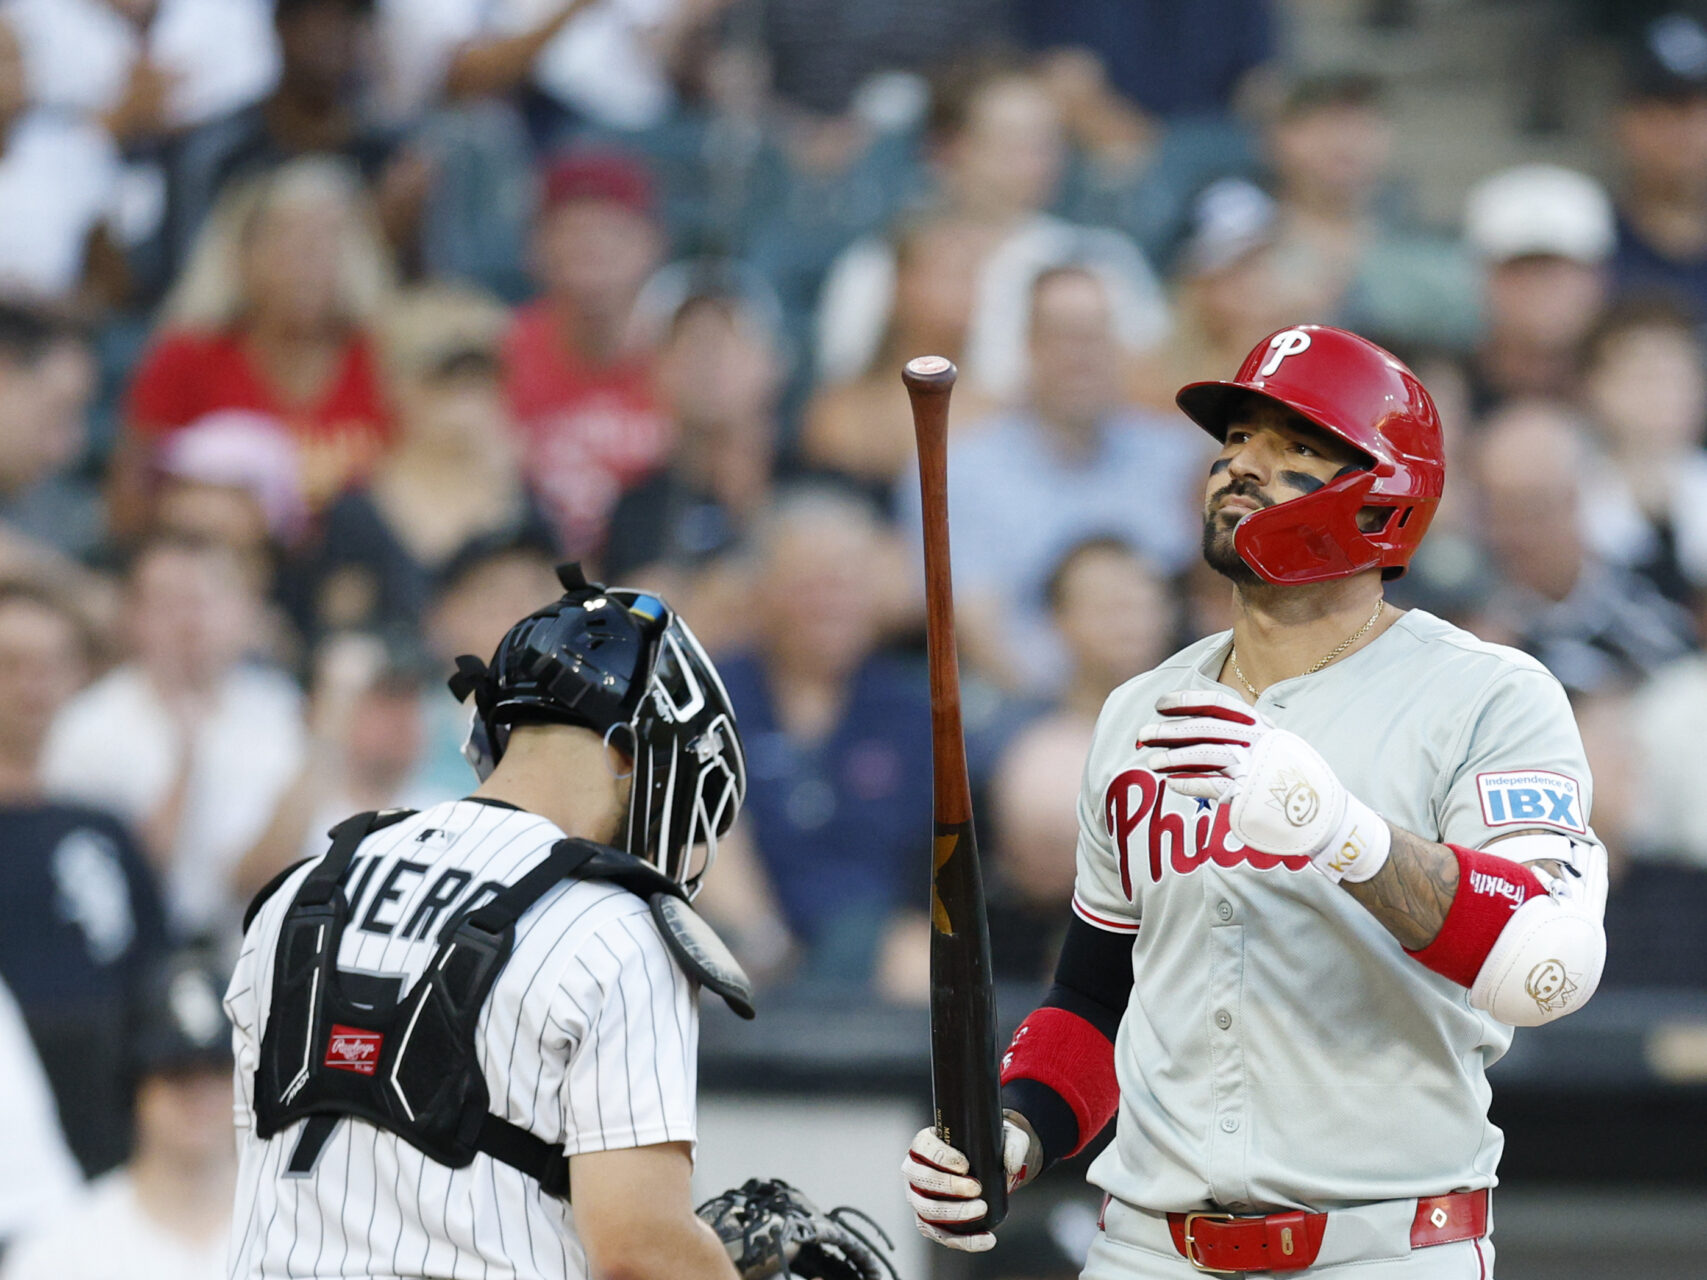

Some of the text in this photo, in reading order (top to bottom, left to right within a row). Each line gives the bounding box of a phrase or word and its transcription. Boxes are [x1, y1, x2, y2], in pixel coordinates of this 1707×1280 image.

[1262, 330, 1311, 377] P
[1485, 775, 1562, 787] Independence
[1487, 788, 1580, 828] IBX
[1328, 824, 1367, 873] KOT
[331, 1038, 376, 1060] Rawlings
